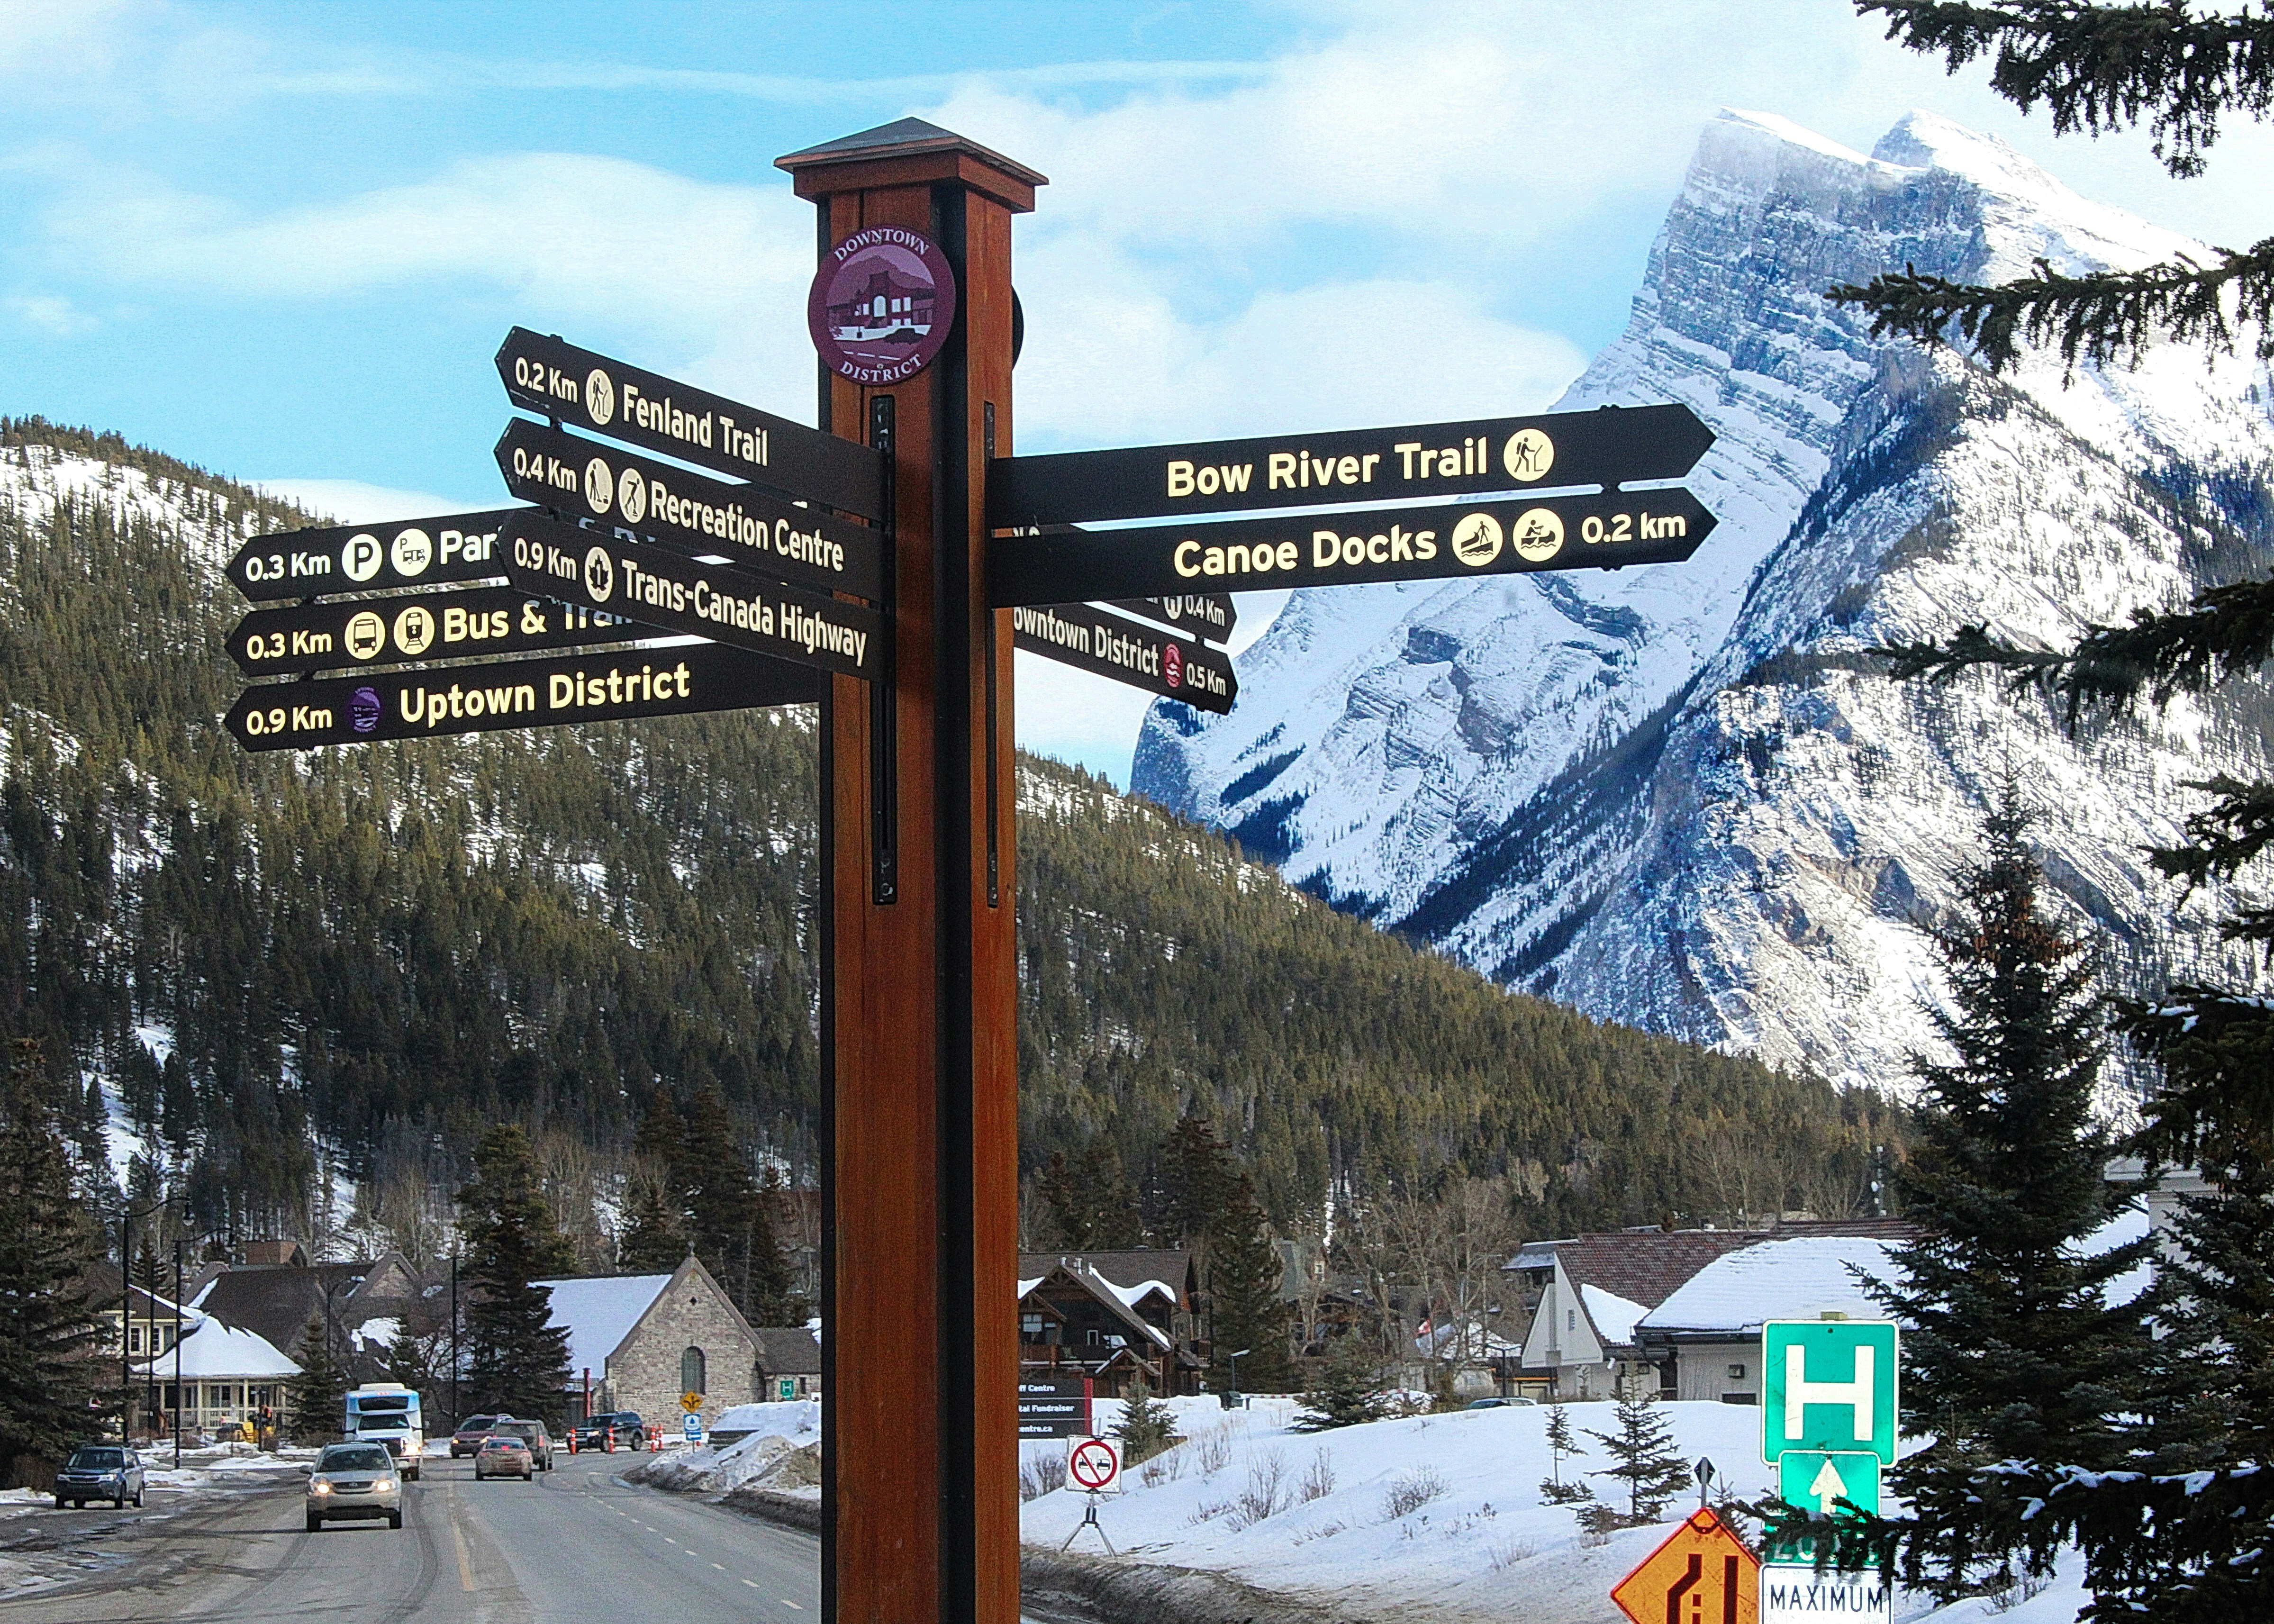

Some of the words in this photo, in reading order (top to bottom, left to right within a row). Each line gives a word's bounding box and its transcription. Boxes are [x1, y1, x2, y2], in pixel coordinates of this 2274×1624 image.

[833, 228, 930, 261] DOWNTOWN
[840, 354, 923, 382] DISTRICT
[516, 357, 544, 392] 0.2
[550, 368, 577, 402] Km
[624, 383, 712, 448] Fenland
[719, 416, 767, 466] Trail
[1169, 461, 1252, 497] Bow
[1269, 451, 1380, 489] River
[1395, 437, 1486, 479] Trail
[514, 448, 544, 481] 0.4
[549, 457, 576, 491] Km
[652, 480, 768, 550] Recreation
[775, 519, 843, 571] Centre
[246, 555, 284, 581] 0.3
[291, 552, 330, 577] Km
[441, 530, 496, 564] Par
[1174, 541, 1298, 577] Canoe
[1314, 525, 1436, 567] Docks
[1582, 514, 1631, 543] 0.2
[1641, 512, 1685, 539] km
[247, 633, 285, 659] 0.3
[293, 630, 331, 654] Km
[444, 608, 508, 642] Bus
[518, 599, 548, 635] &
[515, 538, 543, 570] 0.9
[549, 546, 576, 580] Km
[622, 559, 773, 635] Trans-Canada
[781, 603, 866, 666] Highway
[1186, 596, 1204, 618] 0.4
[1207, 599, 1224, 626] Km
[1095, 625, 1159, 676] District
[1187, 663, 1205, 688] 0.5
[1208, 670, 1225, 695] Km
[247, 709, 285, 735] 0.9
[293, 706, 332, 730] Km
[401, 684, 534, 730] Uptown
[550, 662, 689, 708] District
[1785, 1345, 1874, 1441] H
[1770, 1584, 1884, 1613] MAXIMUM
